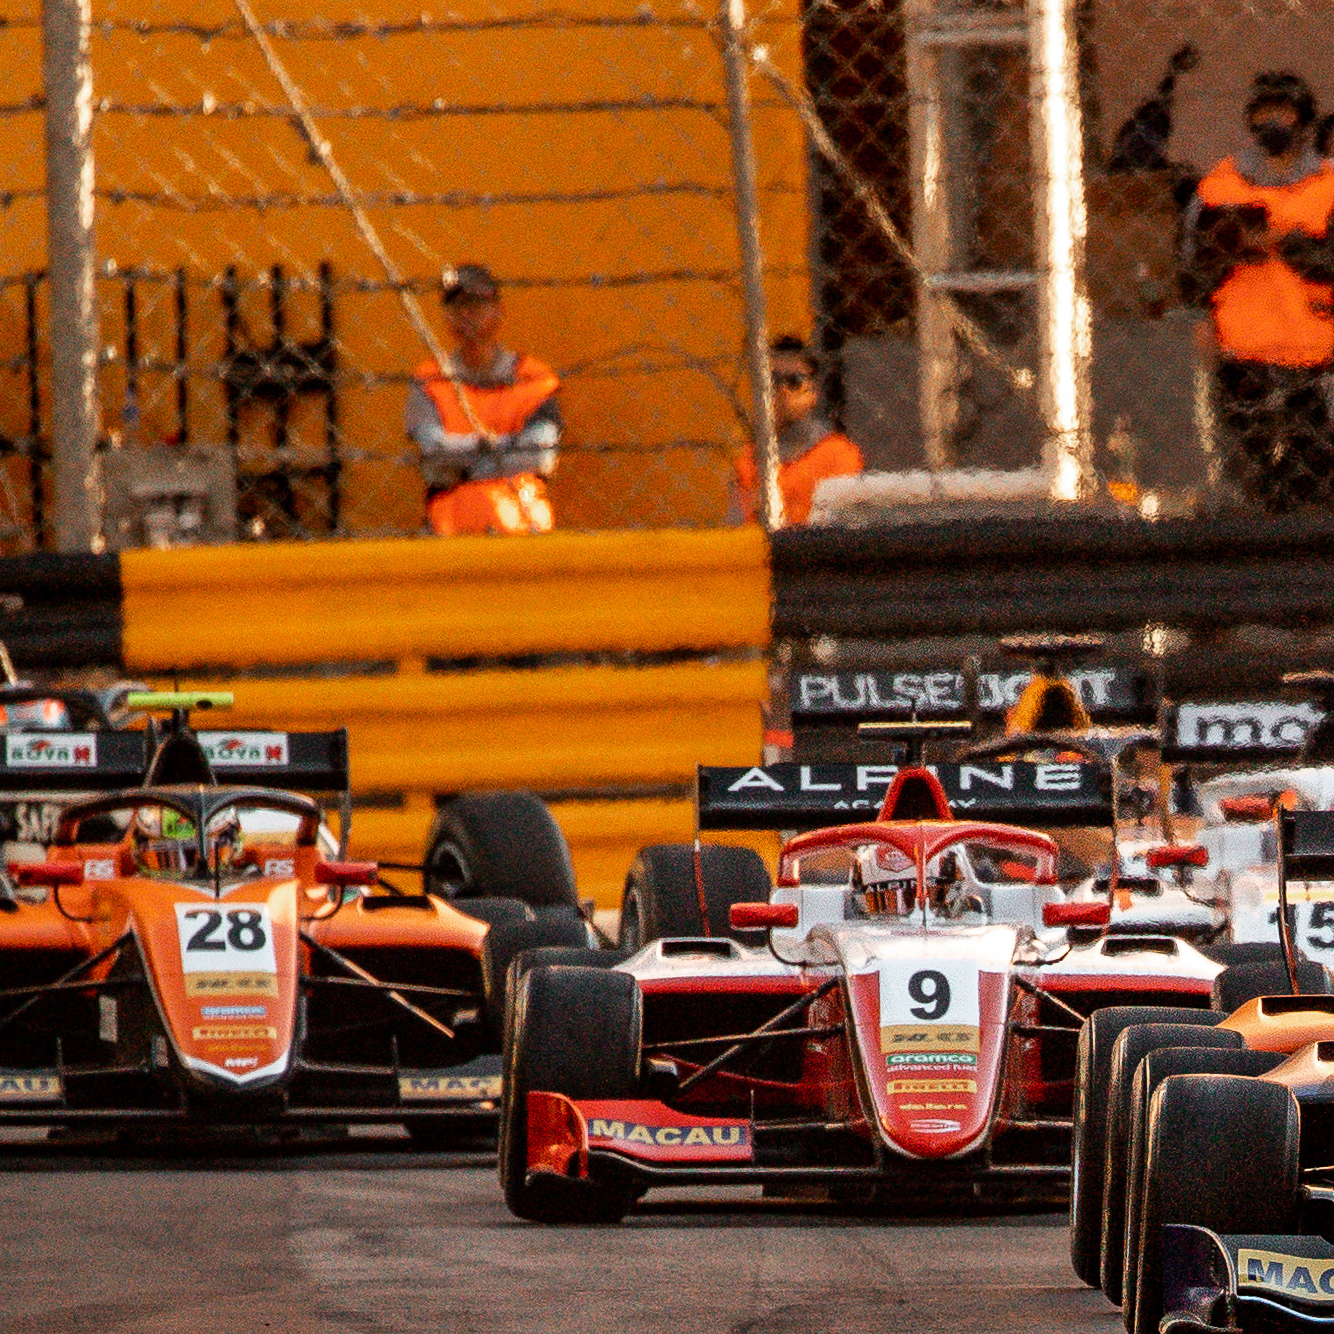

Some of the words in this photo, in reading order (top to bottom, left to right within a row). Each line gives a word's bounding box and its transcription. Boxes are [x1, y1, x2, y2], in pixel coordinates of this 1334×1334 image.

[727, 765, 1083, 791] ALPNE
[184, 908, 267, 952] 28
[907, 969, 952, 1021] 9
[889, 1053, 973, 1064] aramco
[593, 1118, 741, 1145] MACAU
